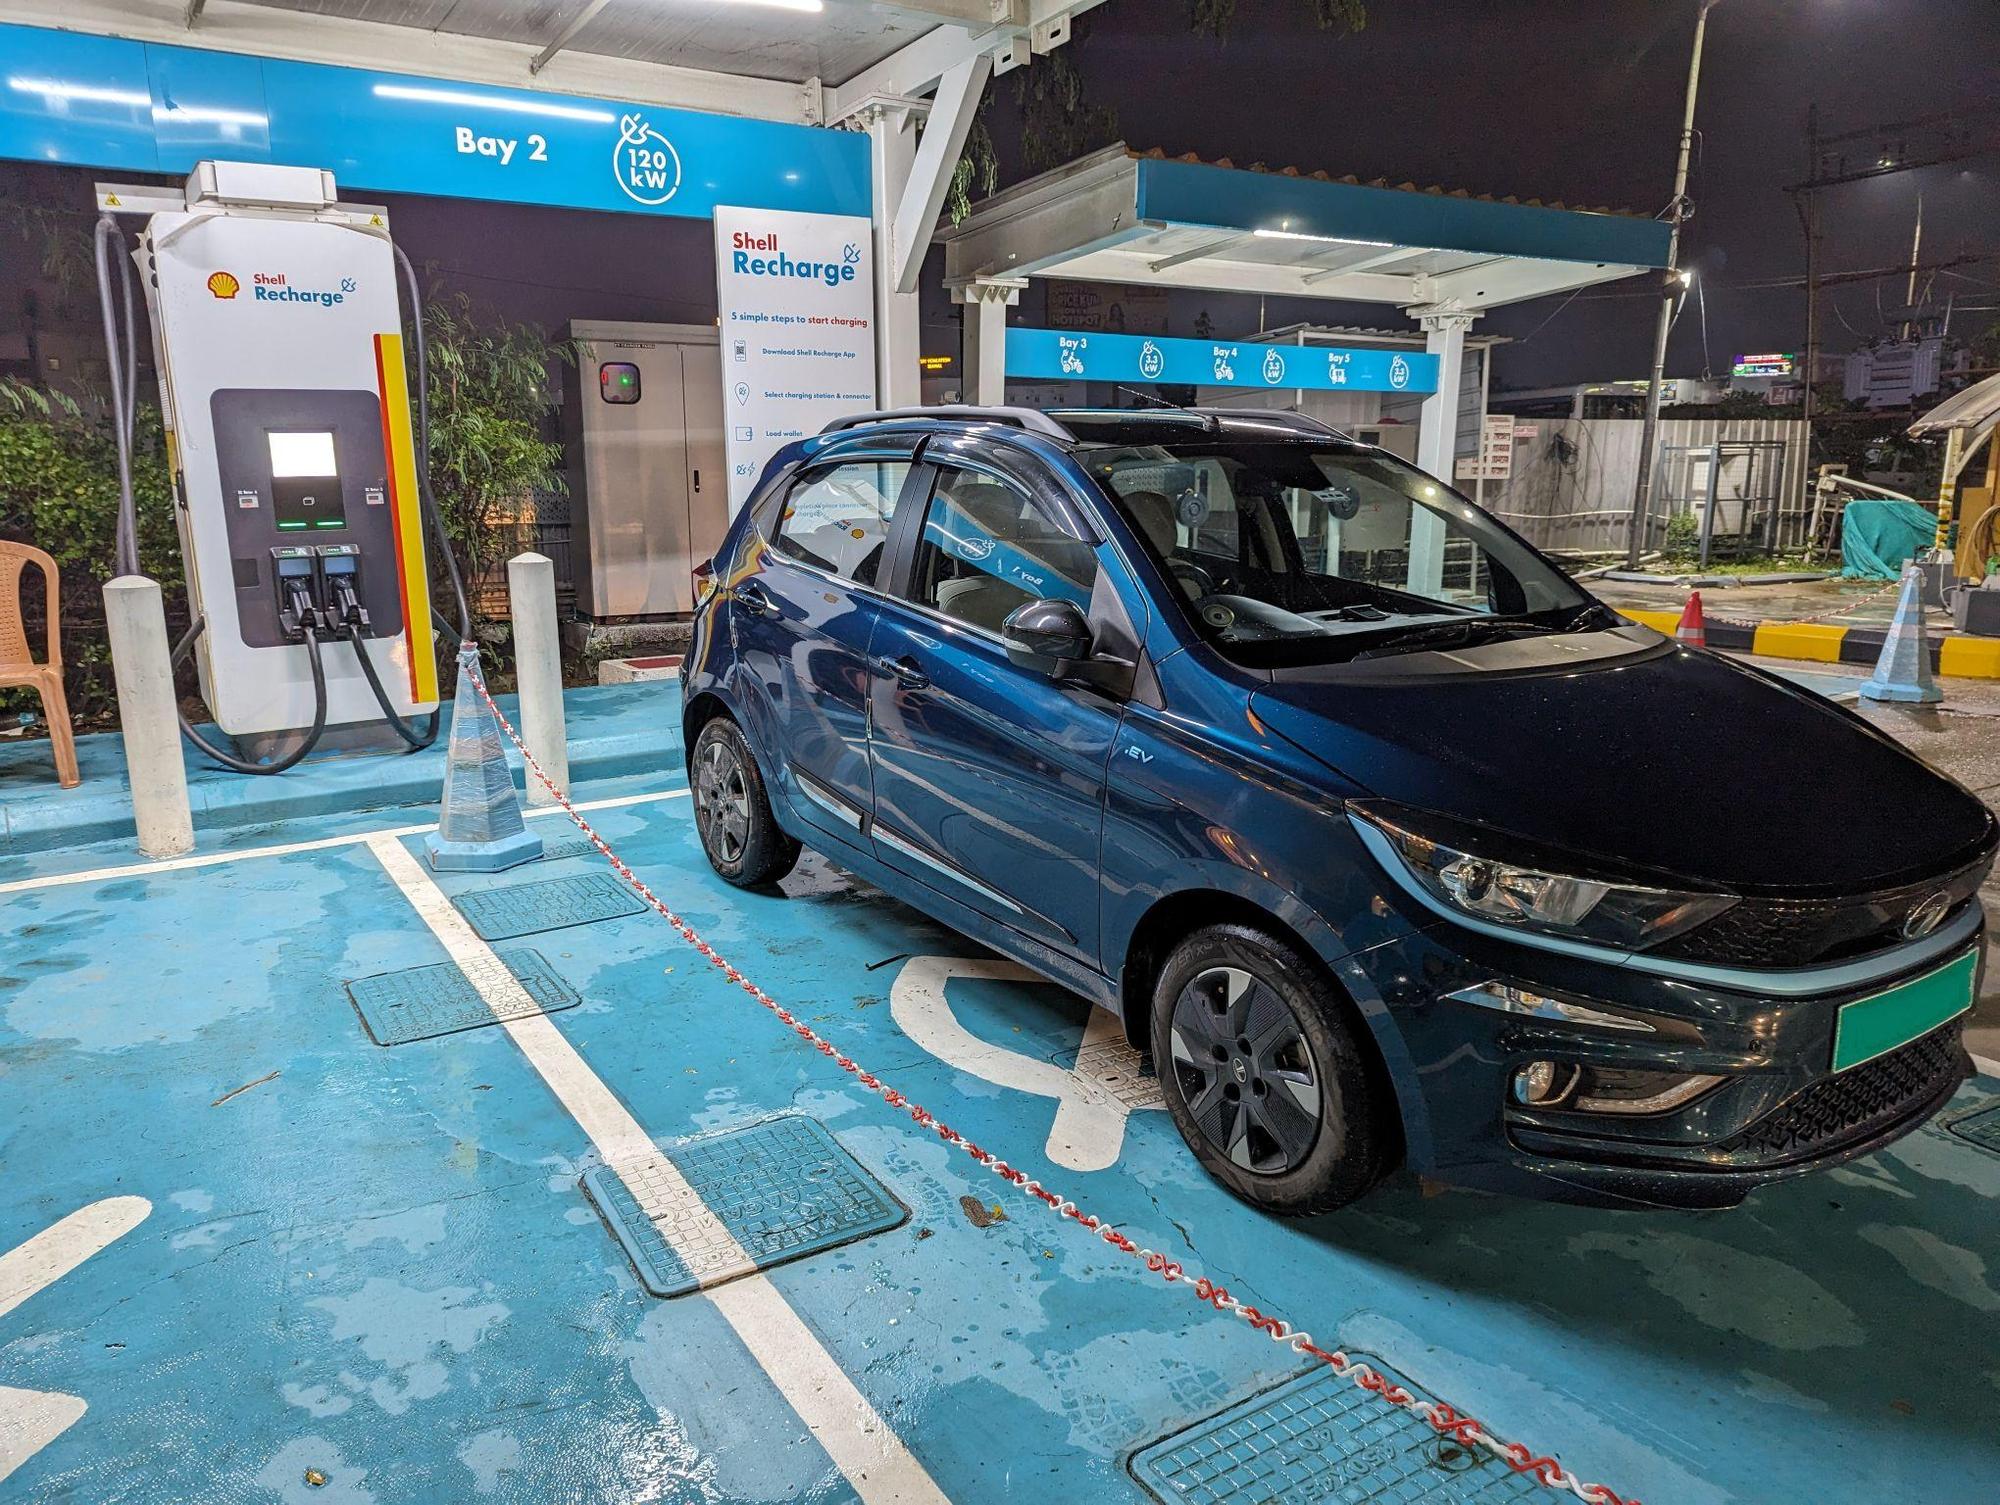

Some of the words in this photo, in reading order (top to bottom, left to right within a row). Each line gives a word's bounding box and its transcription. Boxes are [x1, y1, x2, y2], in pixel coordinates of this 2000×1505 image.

[455, 126, 517, 165] Bay
[527, 134, 548, 162] 2
[628, 148, 667, 170] 120
[630, 167, 667, 189] kW
[733, 231, 777, 252] Shell
[733, 251, 855, 287] Recharge
[254, 273, 285, 286] Shell
[254, 286, 343, 307] Recharge
[731, 312, 737, 320] 5
[739, 311, 769, 323] simple
[771, 315, 794, 325] steps
[808, 316, 829, 325] start
[831, 317, 868, 328] charging
[1059, 336, 1079, 350] Bay
[1081, 338, 1087, 349] 3
[813, 350, 841, 359] Recharge
[843, 351, 856, 359] App
[1145, 355, 1158, 364] 3.3
[1213, 346, 1230, 359] Bay
[1231, 347, 1237, 357] 4
[1328, 352, 1344, 364] Bay
[1344, 353, 1350, 363] 5
[1144, 364, 1158, 372] kW
[785, 392, 813, 400] charging
